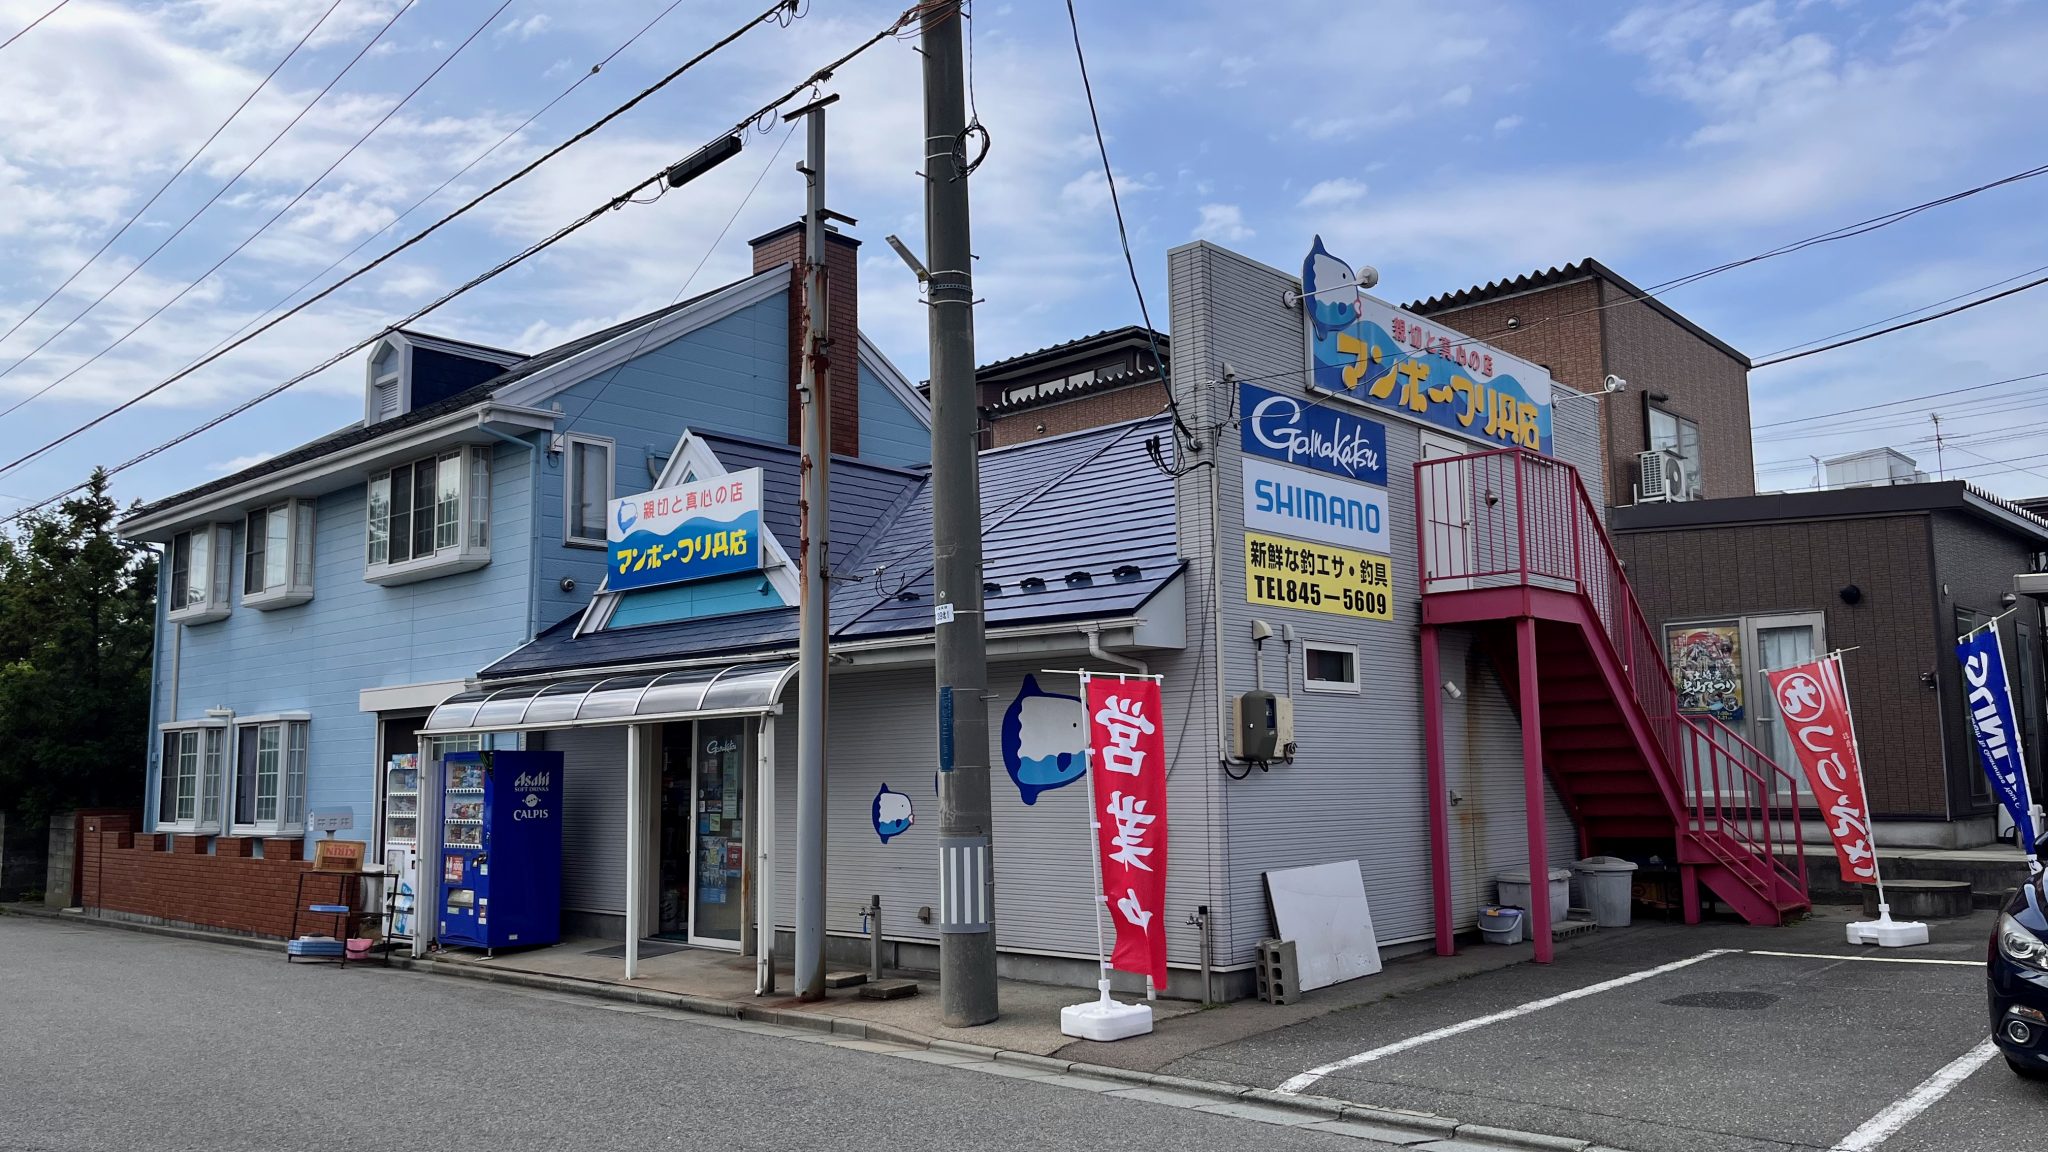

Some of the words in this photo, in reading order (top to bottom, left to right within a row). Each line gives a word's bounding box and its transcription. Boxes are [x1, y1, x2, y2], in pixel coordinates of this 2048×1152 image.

[1392, 316, 1494, 377] 親切と真心の店
[1252, 395, 1380, 478] Gamakatsu
[643, 481, 743, 520] 親切と真心の店
[1254, 479, 1380, 534] SHIMANO
[1250, 539, 1388, 587] 新鮮な釣エサ・釣具
[514, 771, 550, 787] Asahi
[513, 809, 549, 821] CALPIS
[326, 847, 356, 856] KIRIN
